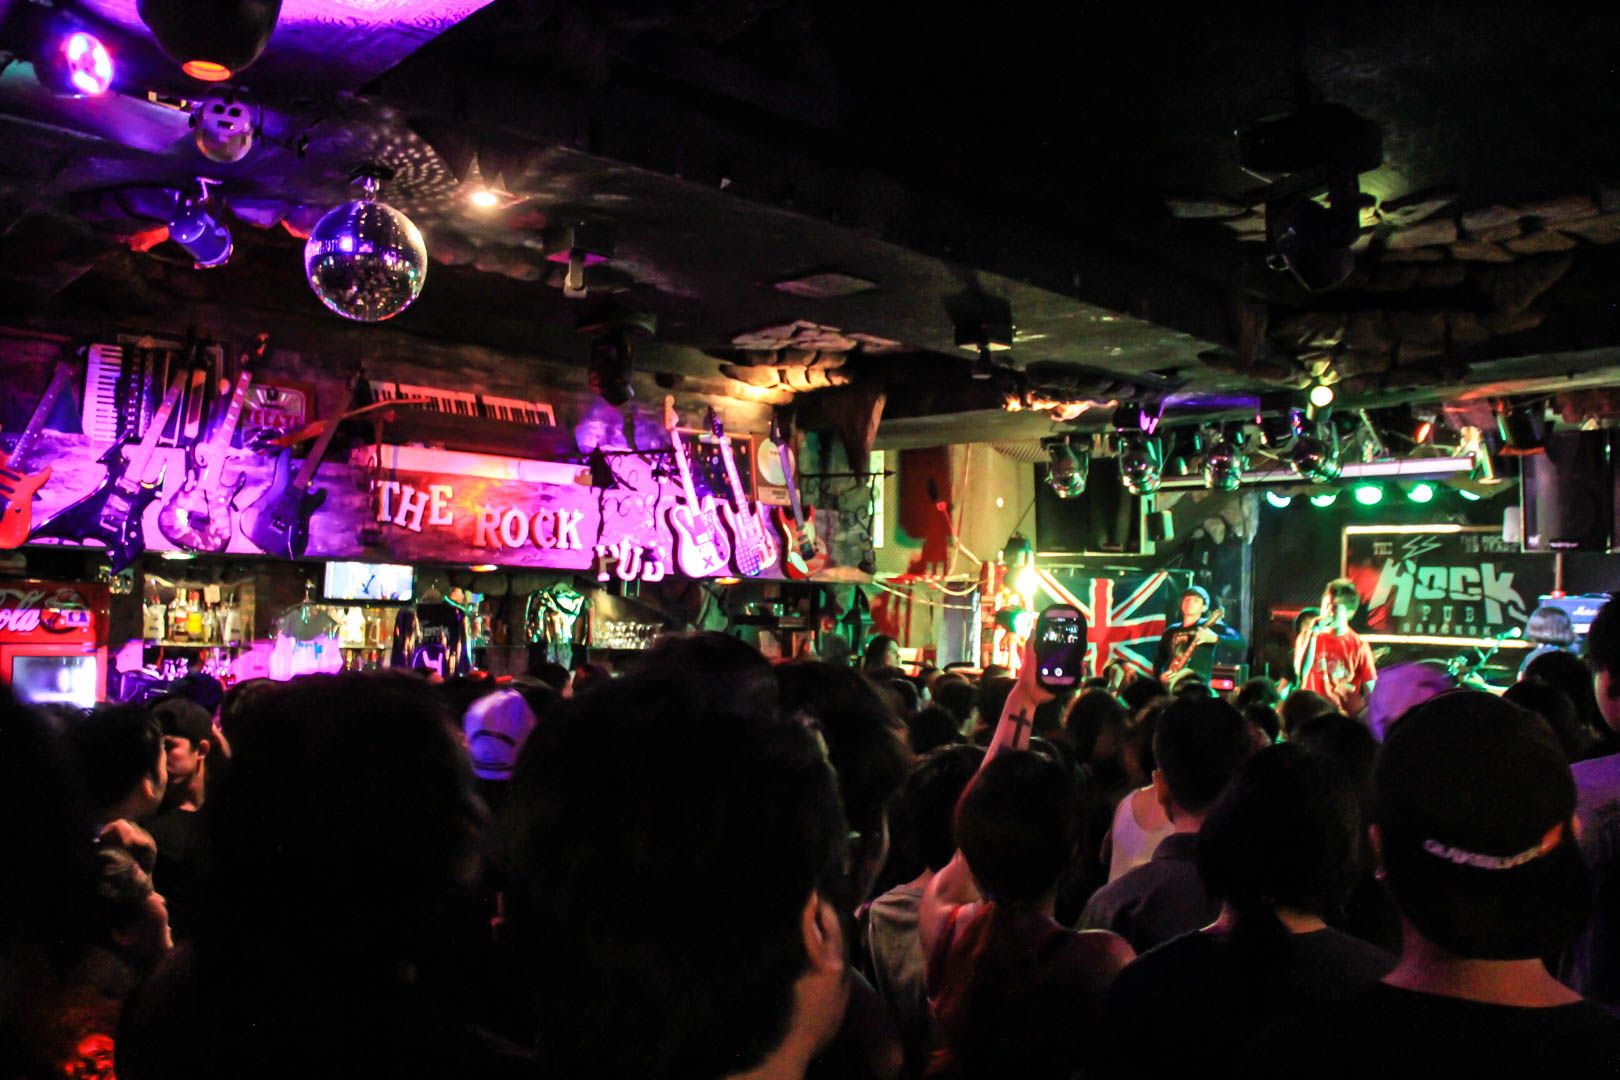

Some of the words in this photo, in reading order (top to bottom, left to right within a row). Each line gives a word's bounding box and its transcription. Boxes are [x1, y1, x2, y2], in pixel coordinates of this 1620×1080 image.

[371, 480, 453, 533] THE
[473, 504, 584, 549] ROCK
[1421, 604, 1475, 623] PUB
